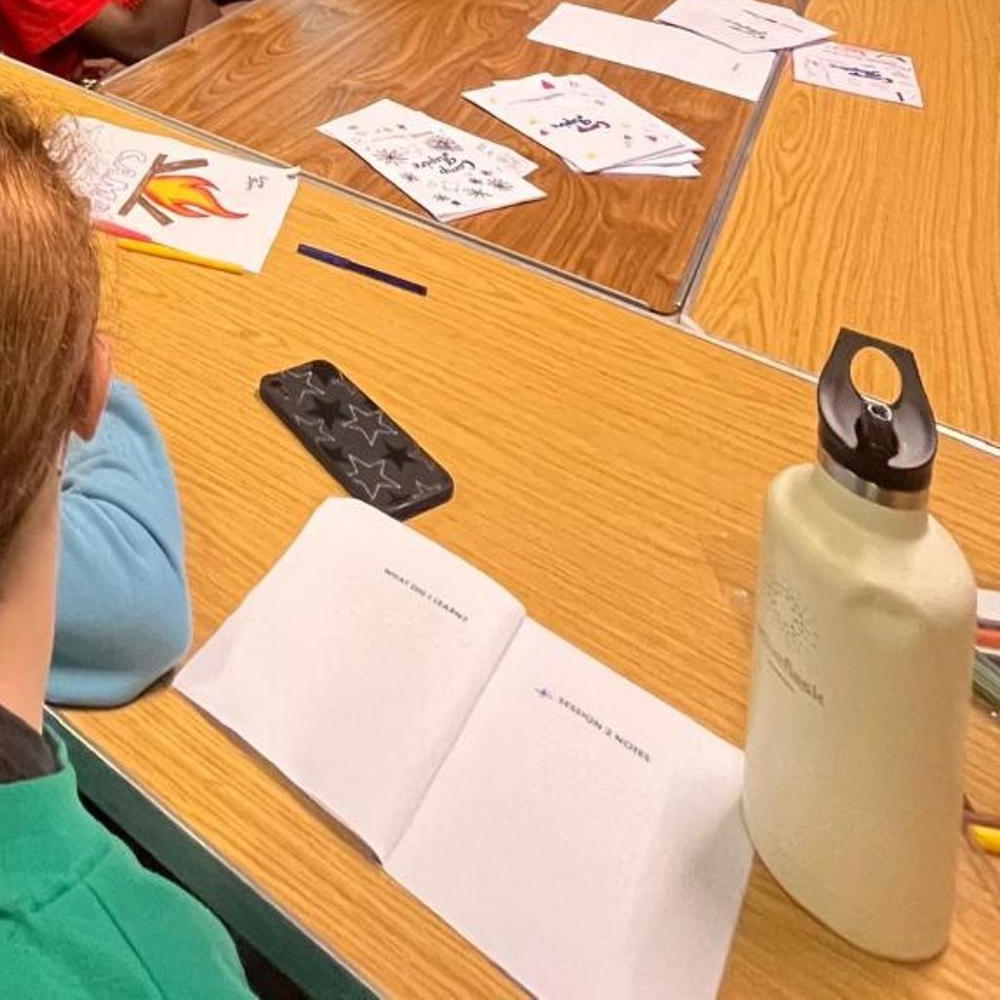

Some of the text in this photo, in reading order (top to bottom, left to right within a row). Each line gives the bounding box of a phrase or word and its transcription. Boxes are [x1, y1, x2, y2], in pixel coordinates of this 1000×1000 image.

[383, 567, 410, 586] WHAT
[410, 583, 427, 597] DID
[433, 598, 469, 623] LEARN?
[558, 696, 603, 732] SESSION
[614, 733, 651, 763] NOTES
